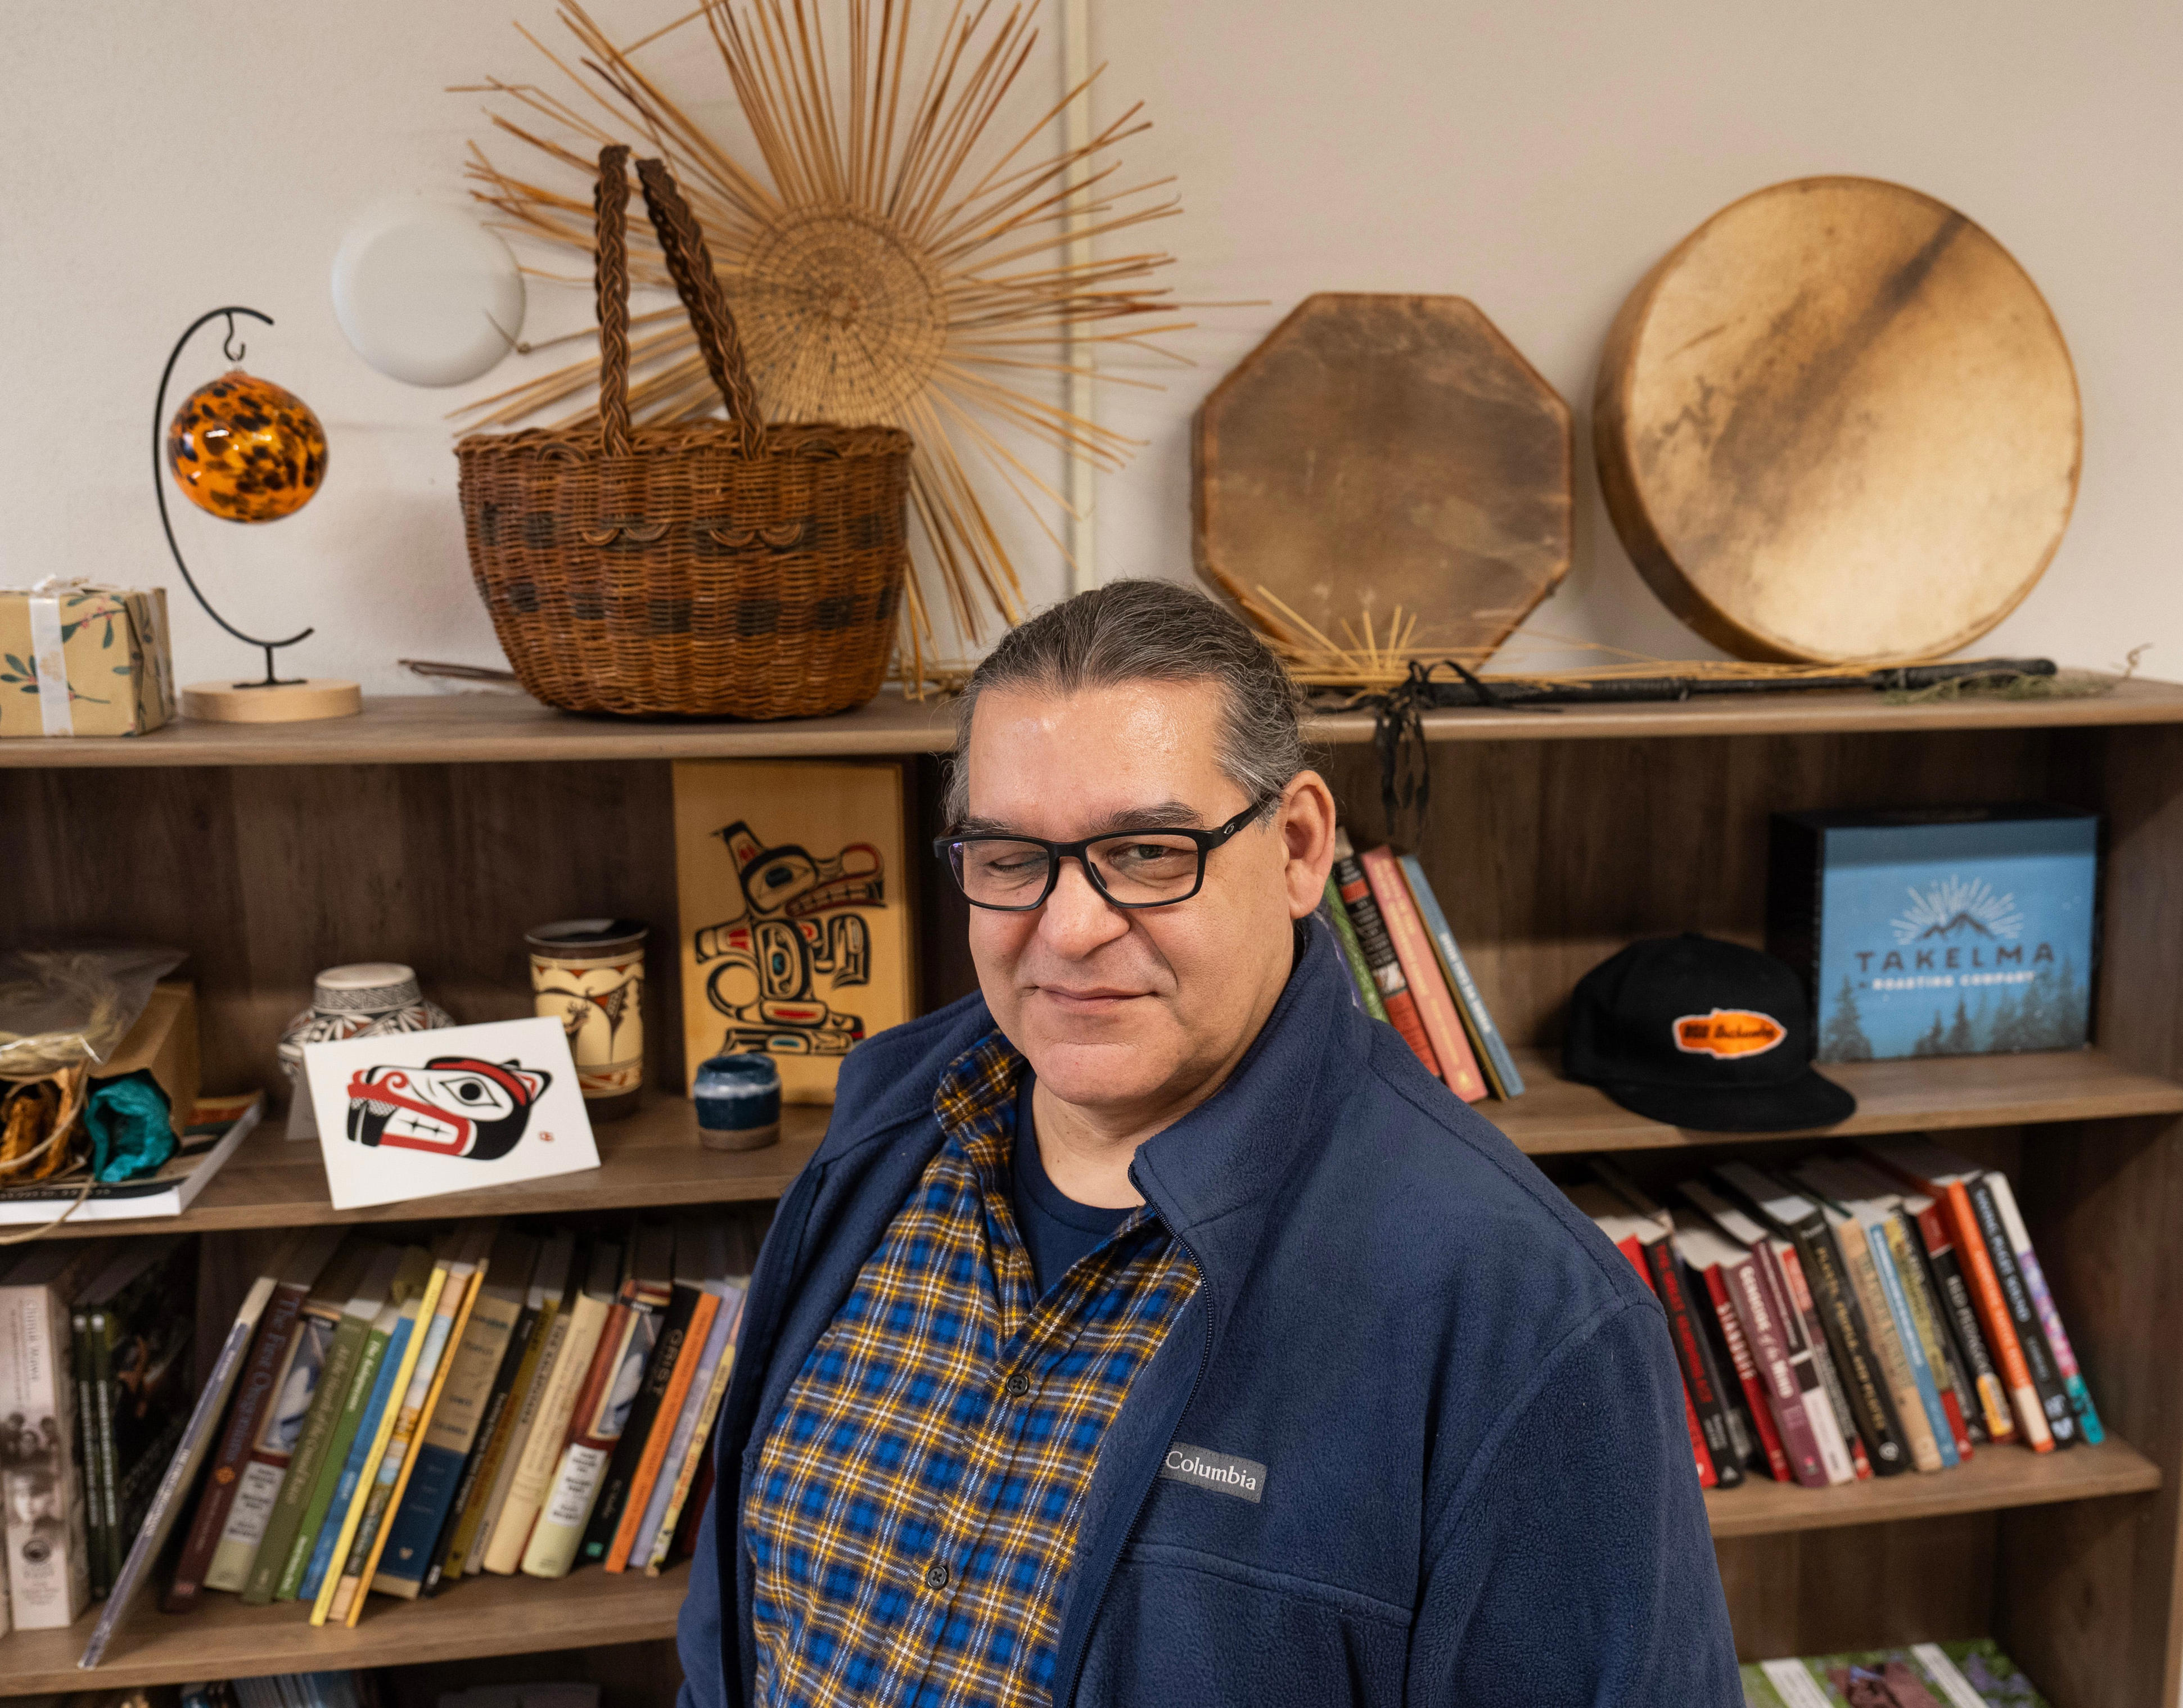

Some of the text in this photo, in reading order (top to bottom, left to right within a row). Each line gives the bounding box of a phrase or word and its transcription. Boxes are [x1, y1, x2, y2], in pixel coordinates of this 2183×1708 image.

[1855, 942, 2055, 973] TAKELMA
[1873, 970, 2036, 991] ROASTING COMPANY
[276, 1294, 299, 1332] The
[261, 1333, 285, 1371] First
[226, 1370, 271, 1464] Oregonians
[1165, 1451, 1256, 1490] Columbia
